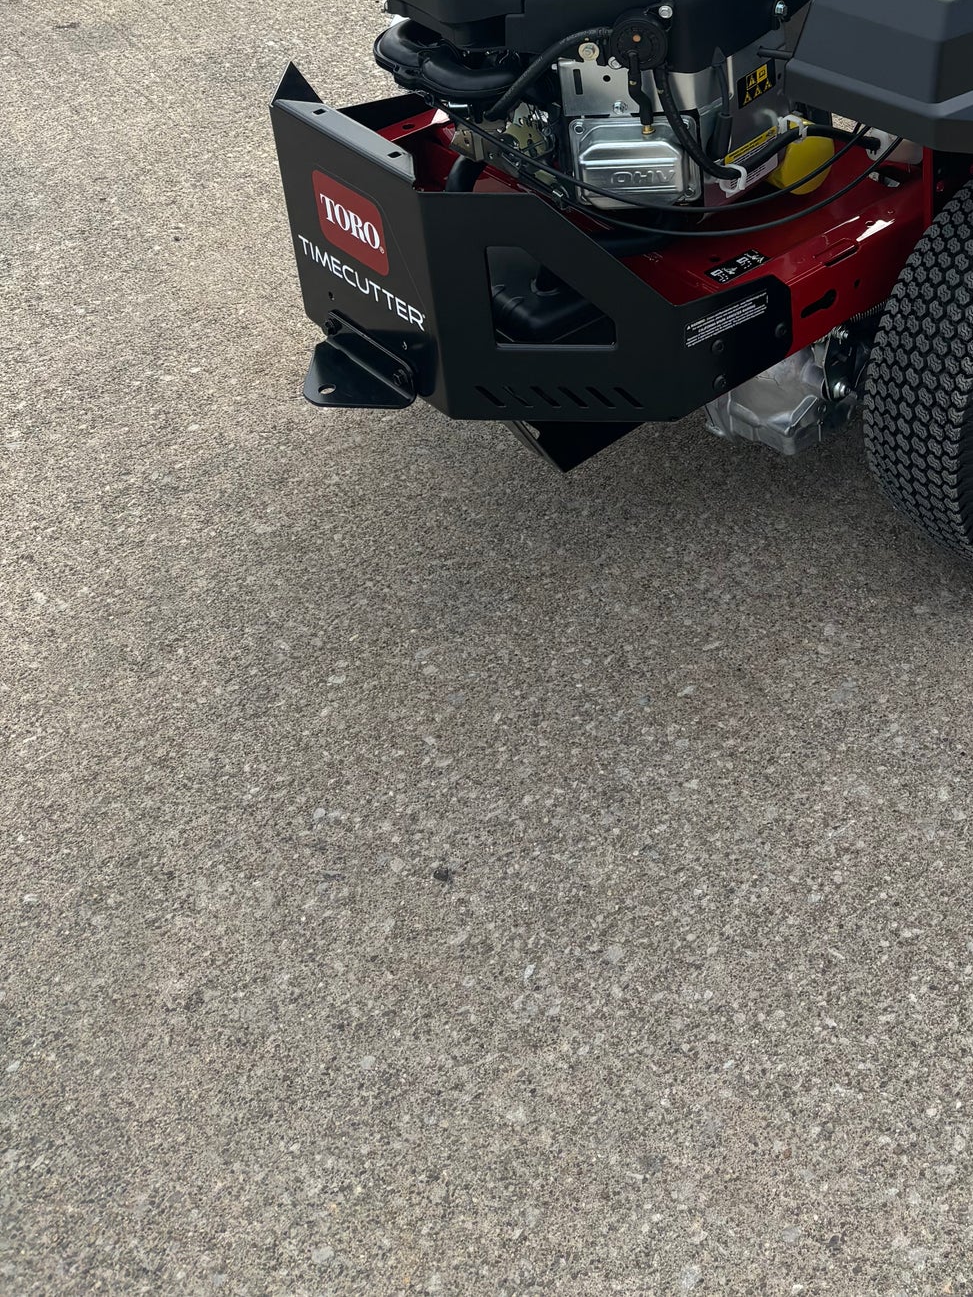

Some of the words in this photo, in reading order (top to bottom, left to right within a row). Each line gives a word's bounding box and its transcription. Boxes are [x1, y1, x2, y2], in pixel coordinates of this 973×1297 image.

[610, 170, 676, 184] OHV
[319, 193, 381, 250] TORO
[298, 234, 425, 332] TIMECUTTER
